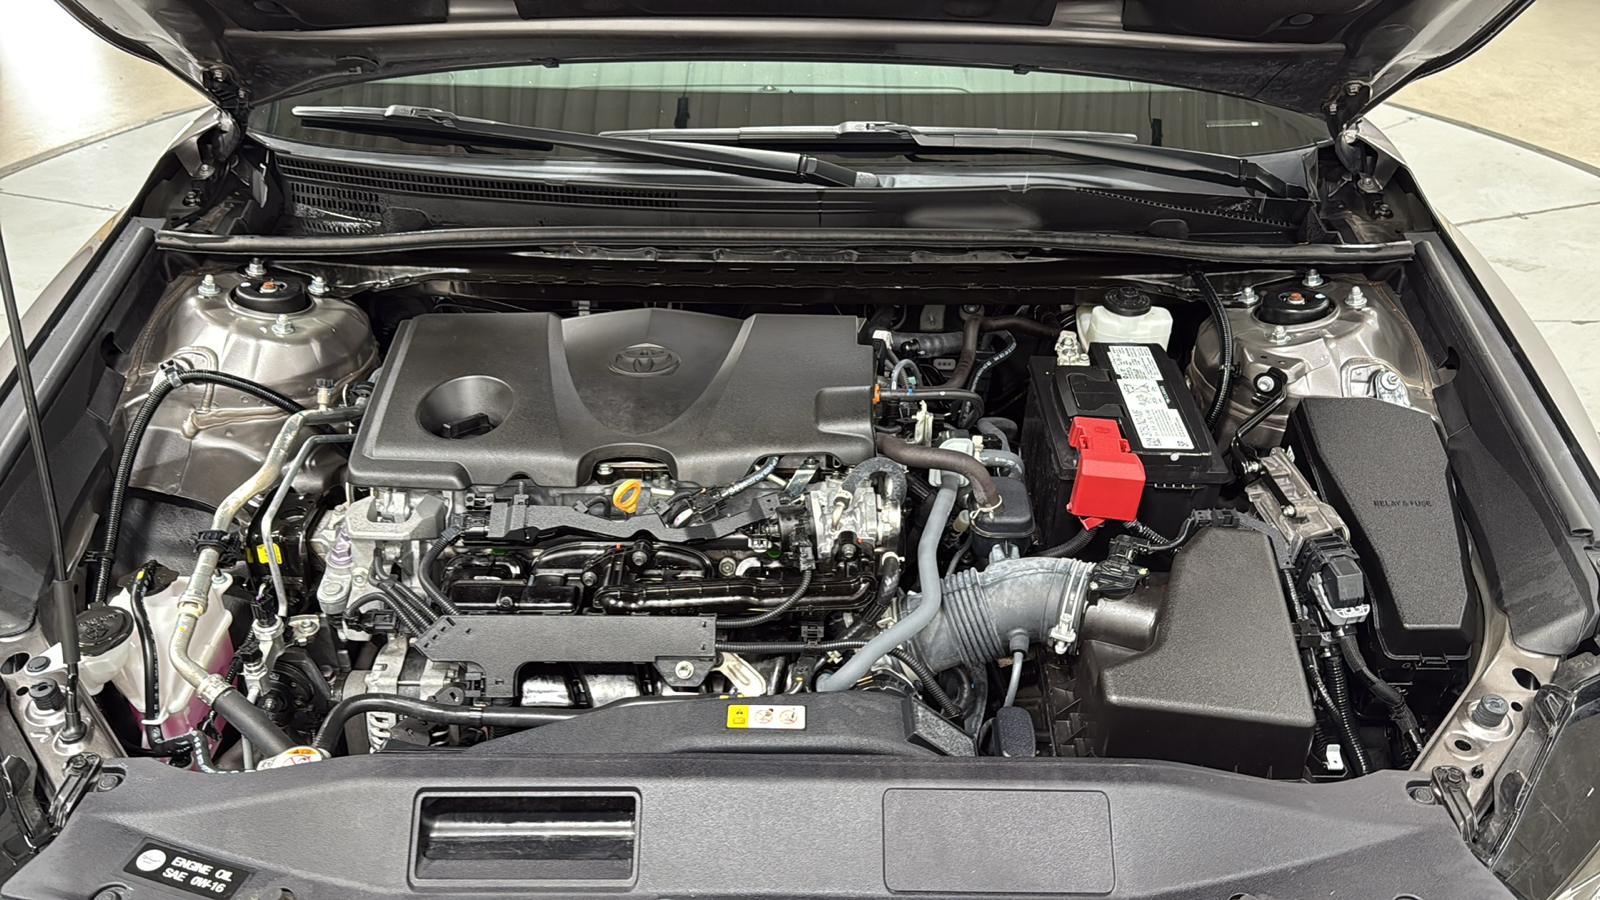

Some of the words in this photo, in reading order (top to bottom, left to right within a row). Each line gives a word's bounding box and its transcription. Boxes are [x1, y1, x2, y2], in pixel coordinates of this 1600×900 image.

[162, 867, 189, 882] SAE
[190, 875, 226, 893] 0W-16
[171, 856, 214, 875] ENGINE
[214, 869, 233, 882] OIL
